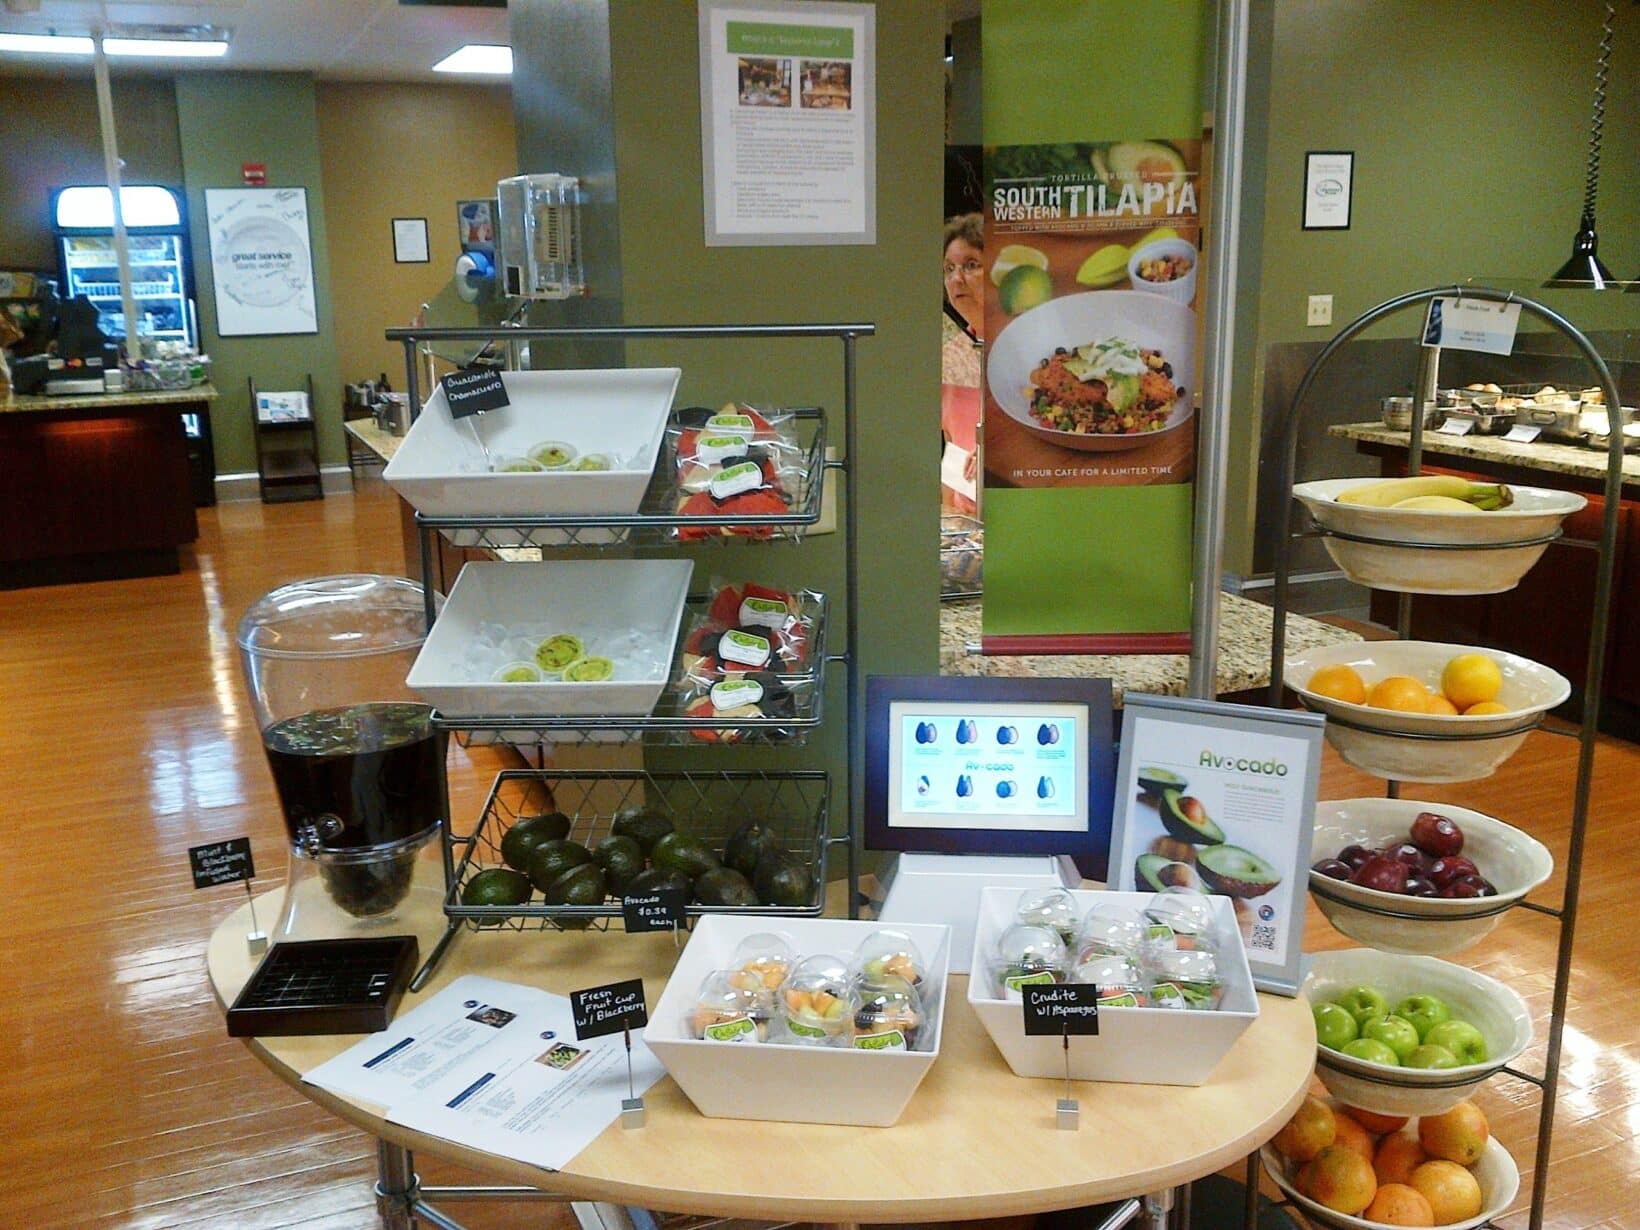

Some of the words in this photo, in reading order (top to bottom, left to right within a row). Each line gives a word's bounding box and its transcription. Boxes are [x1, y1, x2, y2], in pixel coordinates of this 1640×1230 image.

[1051, 173, 1098, 182] TORTILLA
[993, 186, 1061, 208] SOUTH
[1063, 181, 1198, 218] TILAPIA
[993, 205, 1061, 221] WESTERN
[1013, 469, 1023, 477] IN
[1026, 468, 1051, 478] YOUR
[1054, 468, 1078, 477] CAFE
[1080, 467, 1099, 476] FOR
[1102, 467, 1109, 476] A
[1111, 466, 1148, 476] LIMITED
[1150, 465, 1173, 475] TIME
[1199, 749, 1289, 778] Avocado
[1030, 988, 1079, 1005] Crudite
[585, 997, 612, 1014] Fruit
[596, 1002, 645, 1021] Blackberry
